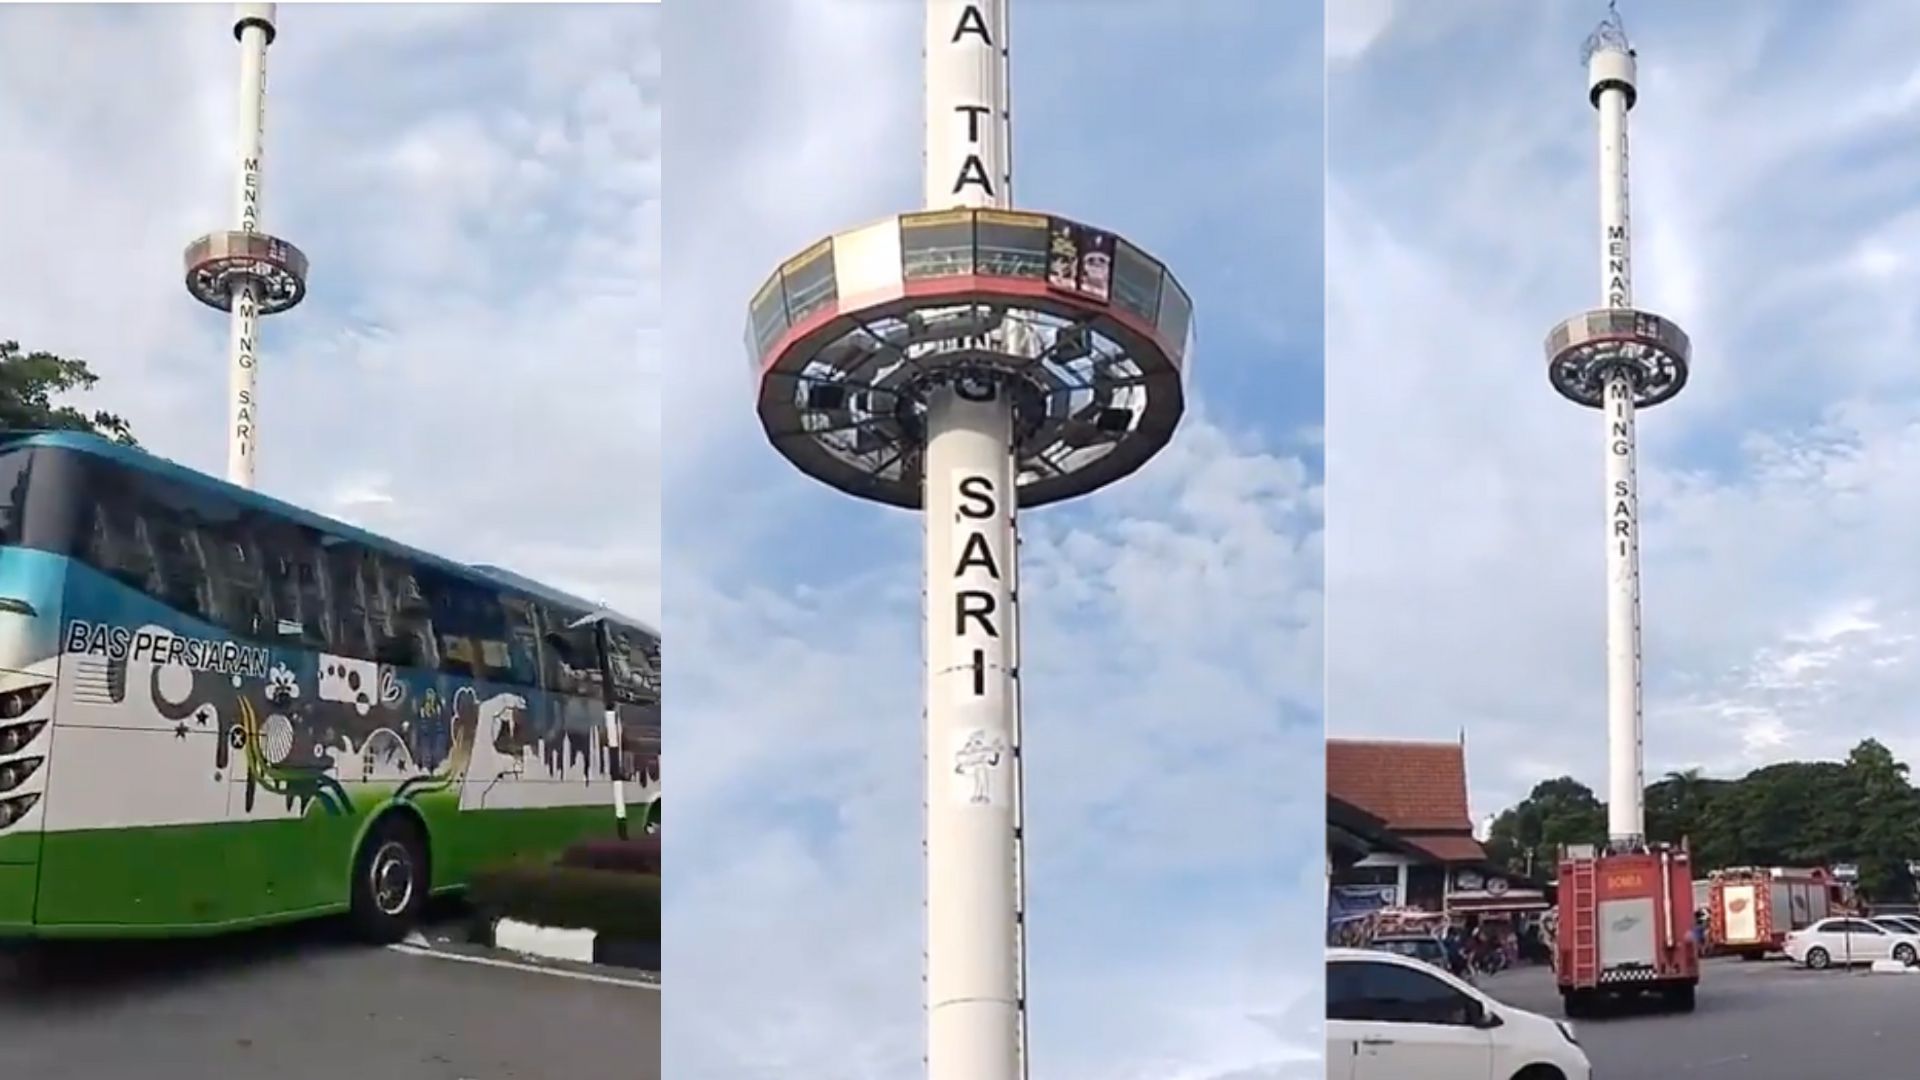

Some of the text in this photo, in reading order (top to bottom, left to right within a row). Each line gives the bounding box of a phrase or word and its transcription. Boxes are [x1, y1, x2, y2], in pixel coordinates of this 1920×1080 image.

[236, 157, 258, 456] MENAR AMING SARI
[1608, 225, 1630, 557] MENAR AMING SARI
[66, 620, 270, 678] BAS PERSIARAN
[954, 476, 1000, 695] SARI
